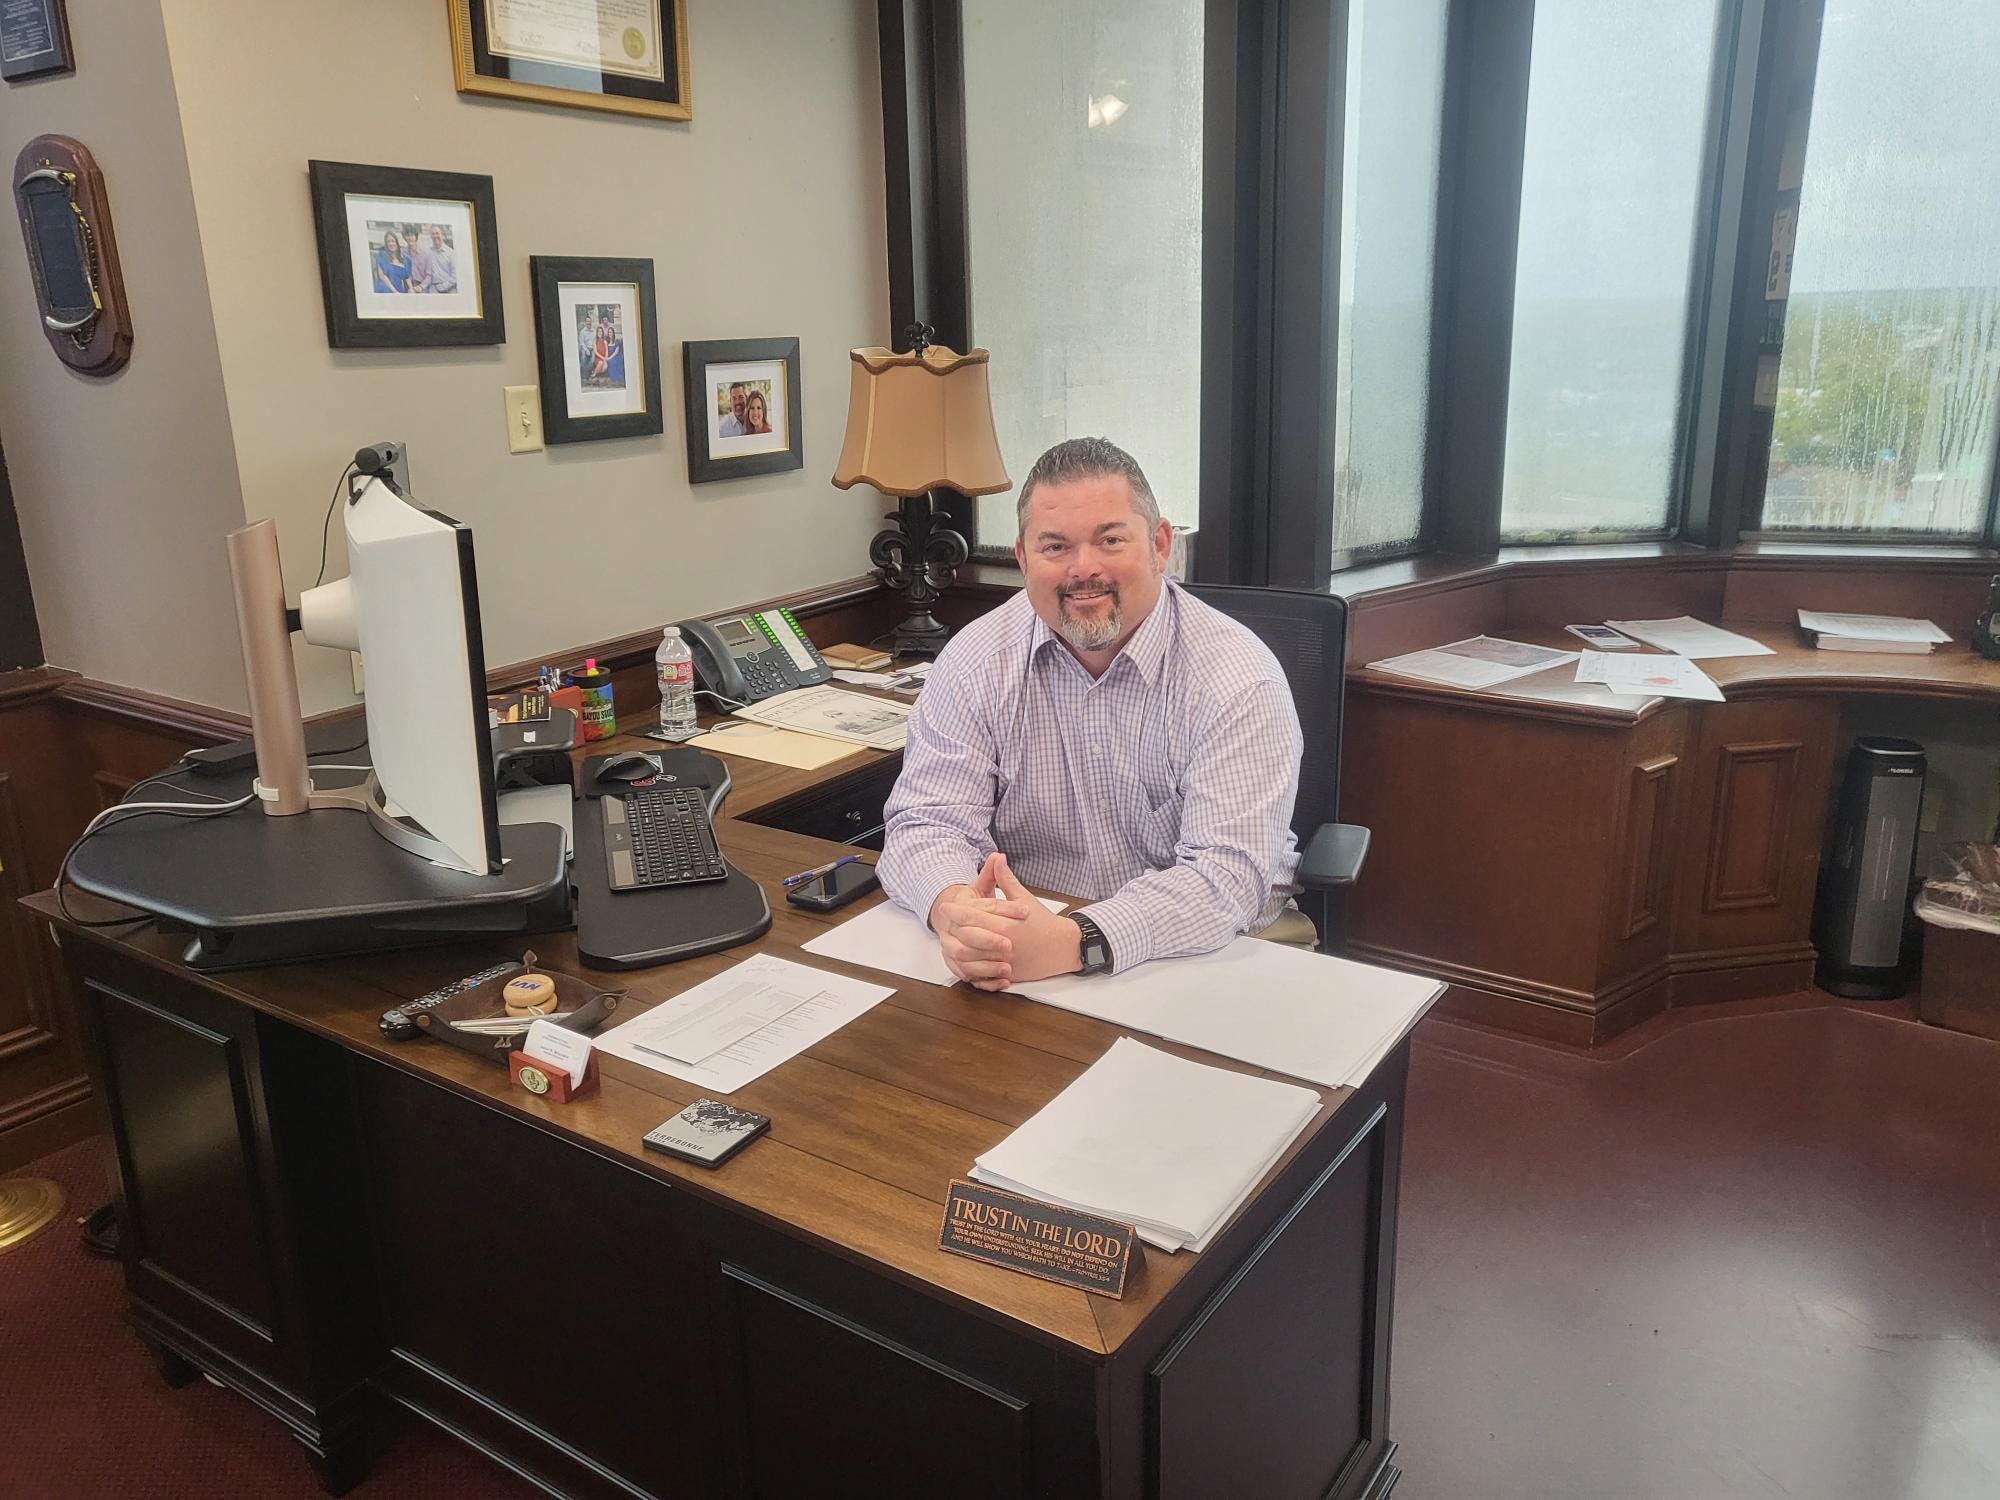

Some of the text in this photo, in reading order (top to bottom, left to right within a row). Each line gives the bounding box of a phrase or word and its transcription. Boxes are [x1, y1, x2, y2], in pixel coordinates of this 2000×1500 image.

[651, 1131, 705, 1151] TERREBONNE
[952, 1197, 1122, 1258] TRUST IN THE LORD
[972, 1224, 983, 1232] THE
[984, 1227, 998, 1236] LORD
[999, 1232, 1014, 1240] WITH
[1025, 1238, 1040, 1247] YOUR
[1071, 1251, 1083, 1259] NOT
[1084, 1254, 1107, 1265] DEPEND
[951, 1233, 963, 1241] AND
[971, 1239, 983, 1247] WILL
[984, 1242, 999, 1251] SHOW
[1000, 1247, 1012, 1255] YOU
[1013, 1250, 1032, 1260] WHICH
[1032, 1256, 1046, 1264] PATH
[953, 1226, 968, 1235] YOUR
[969, 1231, 982, 1239] OWN
[1030, 1247, 1042, 1256] SEEK
[1054, 1254, 1066, 1262] WILL
[1085, 1262, 1097, 1271] YOU
